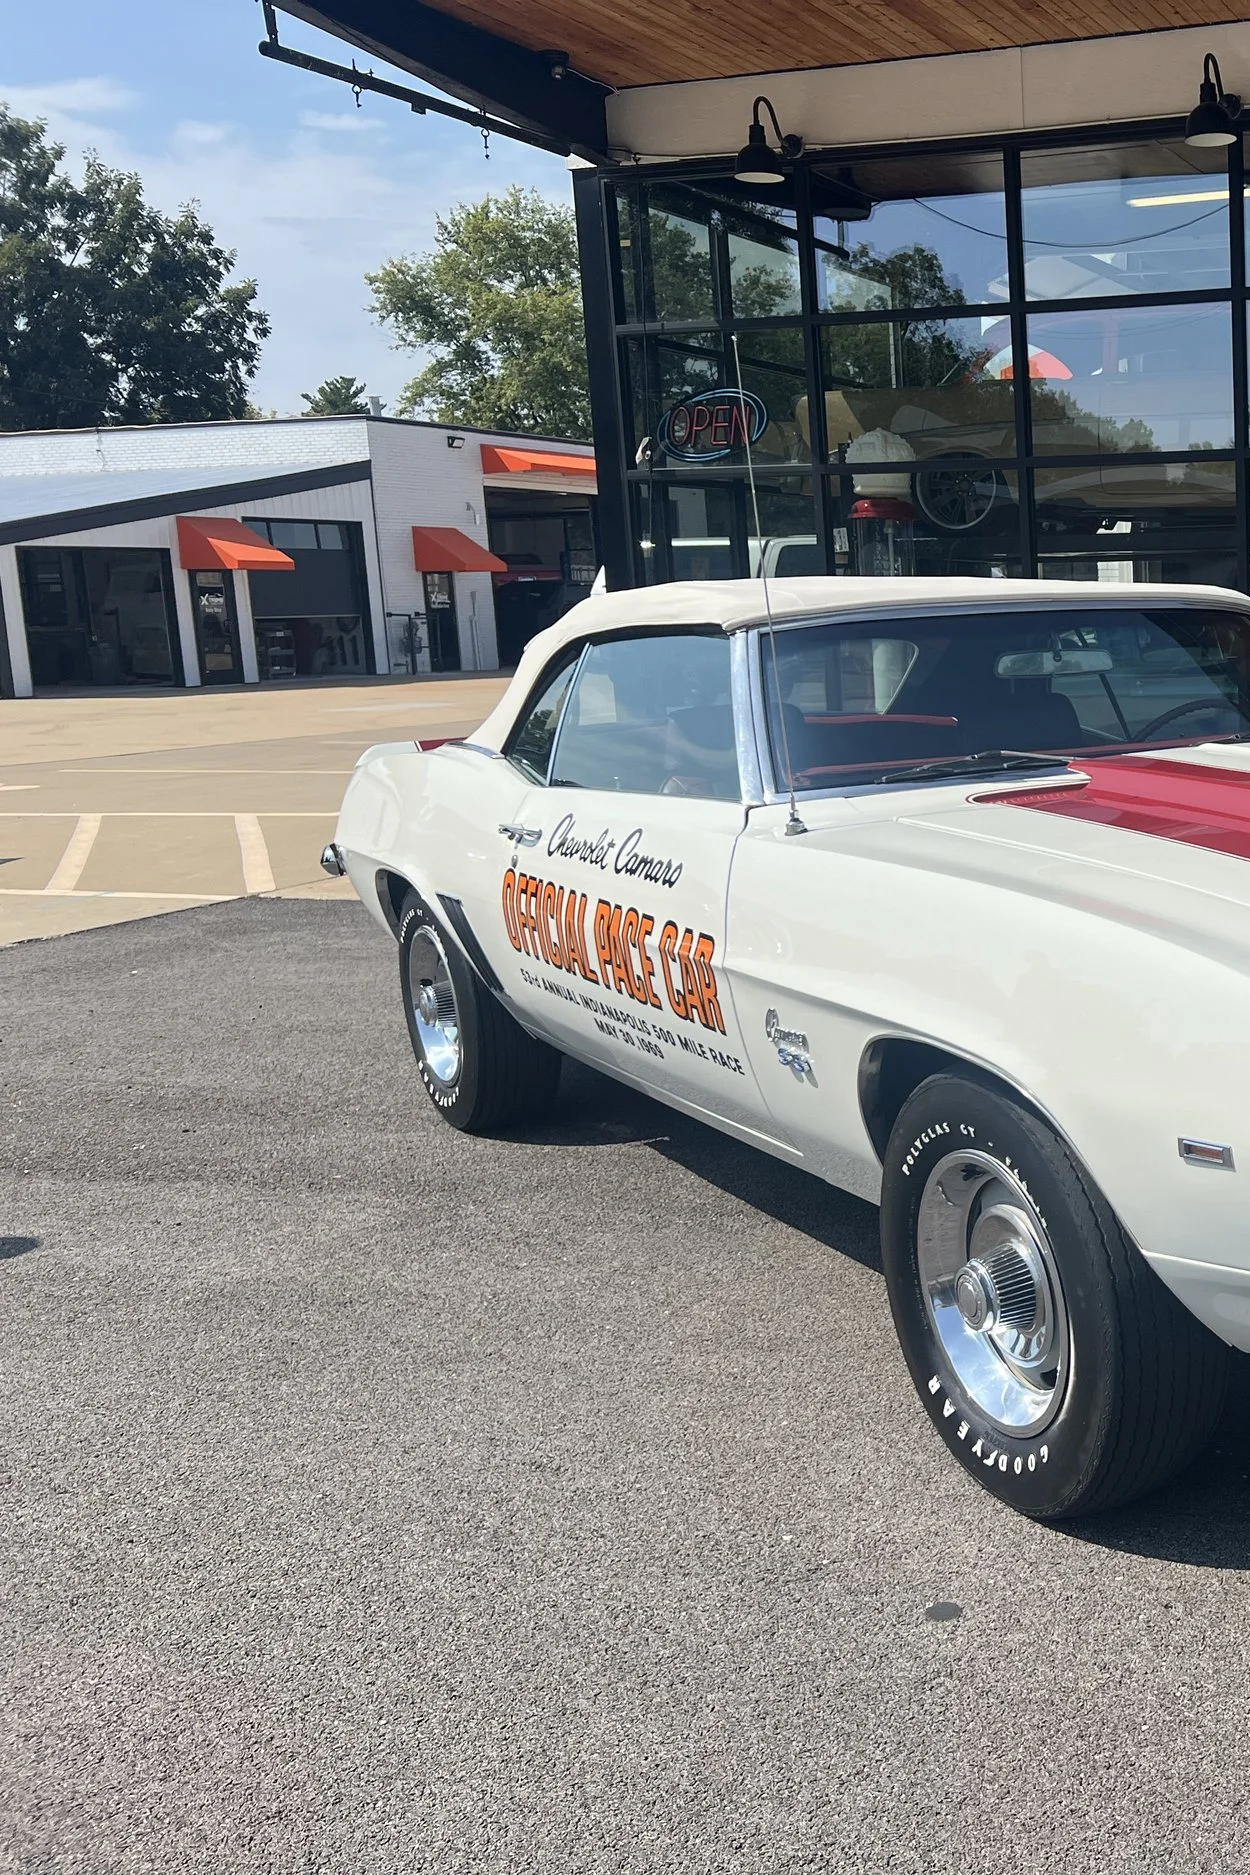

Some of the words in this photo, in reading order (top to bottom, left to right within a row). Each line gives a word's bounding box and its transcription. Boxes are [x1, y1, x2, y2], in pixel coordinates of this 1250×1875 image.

[669, 405, 750, 446] OPEN
[547, 813, 616, 871] Chevrolet
[613, 828, 683, 888] Camaro
[502, 867, 599, 985] OFFICIAL
[594, 898, 663, 1011] PACE
[658, 919, 727, 1036] CAR
[520, 967, 541, 989] 53rd
[541, 977, 580, 1006] ANNUAL
[579, 993, 651, 1036] INDIANAPOLIS
[652, 1024, 677, 1046] 500
[677, 1034, 709, 1060] MILE
[709, 1047, 745, 1075] RACE
[594, 1018, 618, 1039] MAY
[901, 1122, 950, 1176] POLYGLAS
[959, 1123, 976, 1138] GT
[928, 1374, 1049, 1475] GOODYEAR
